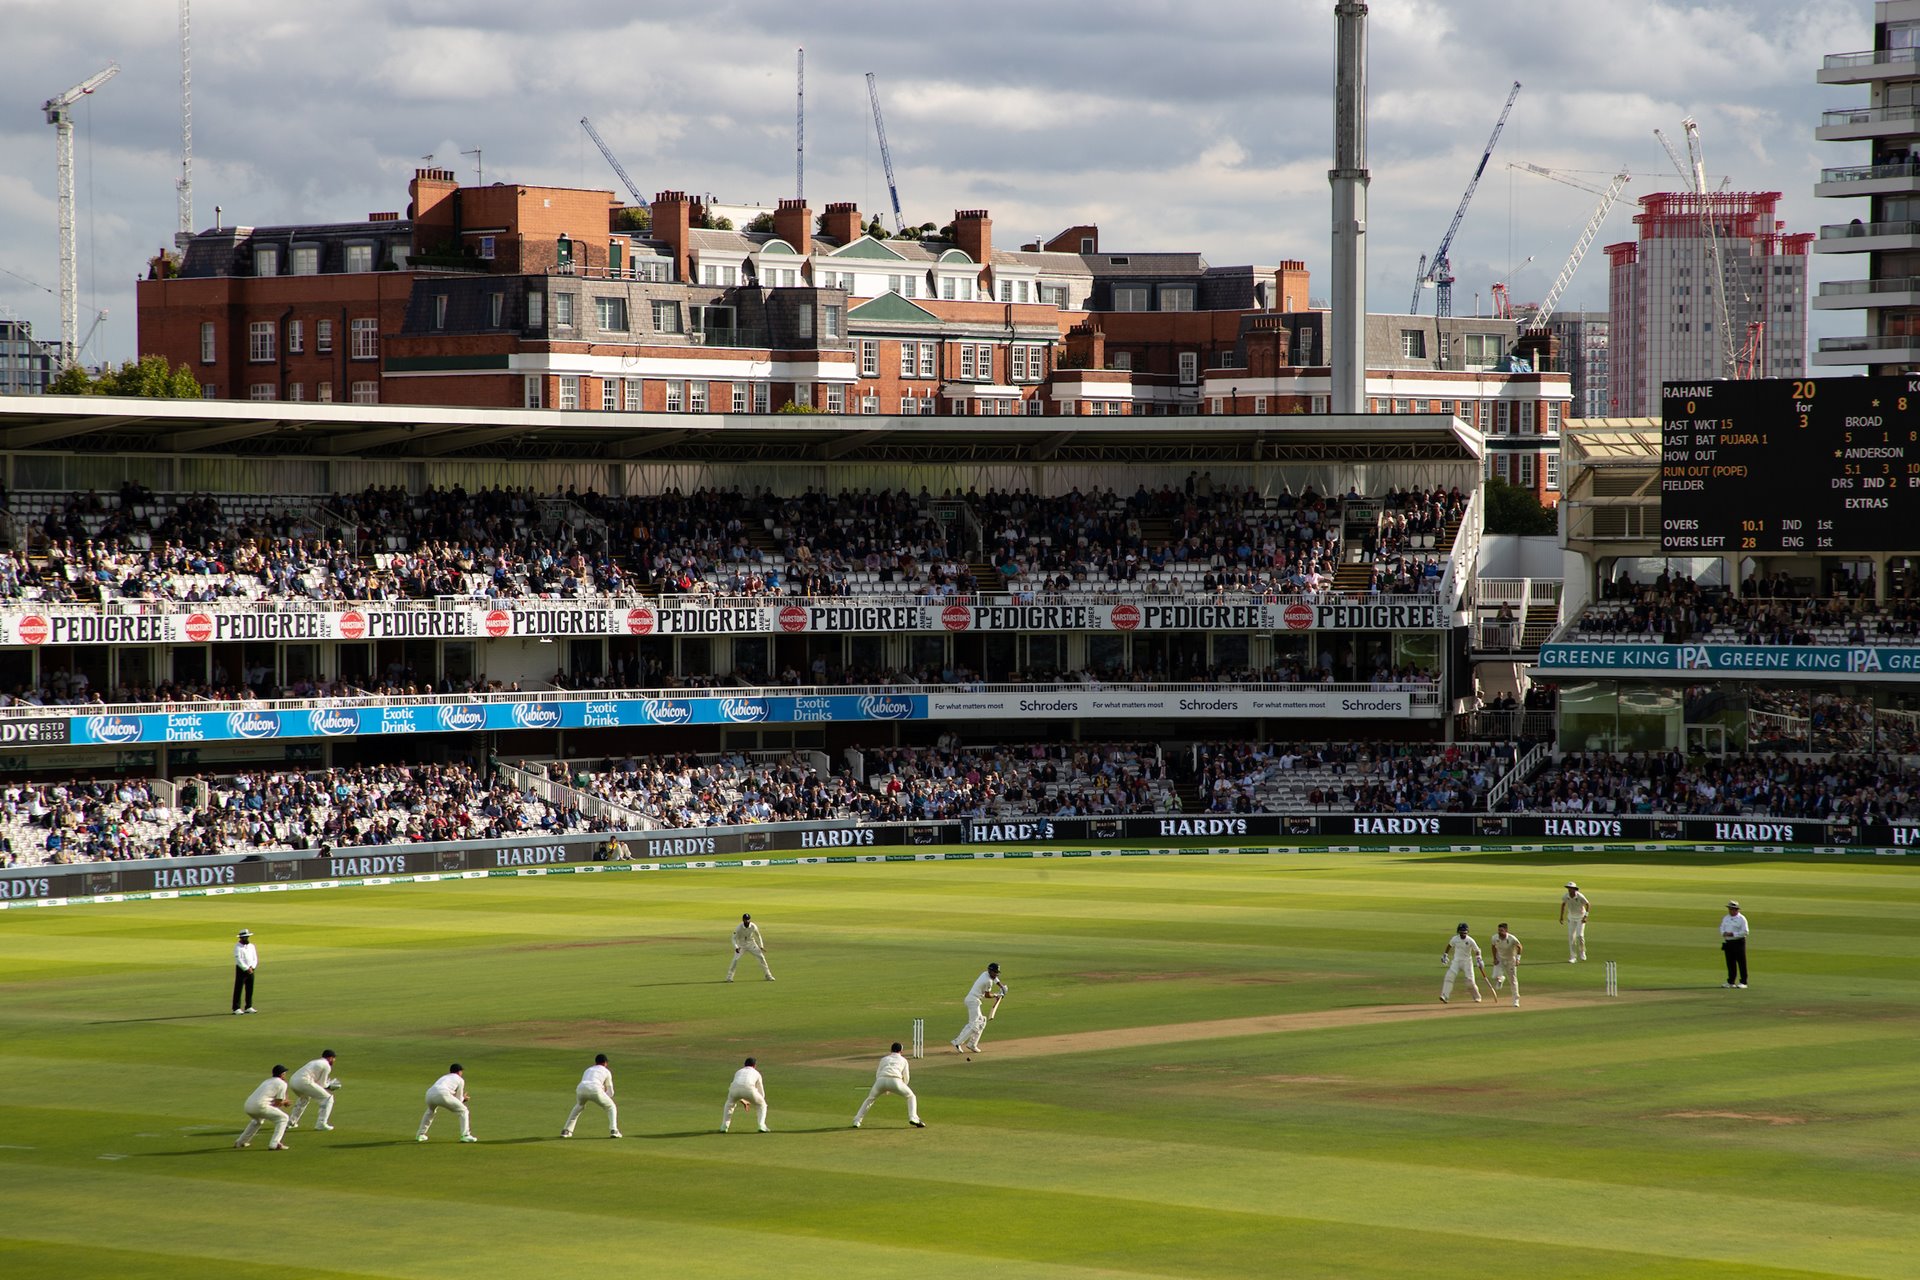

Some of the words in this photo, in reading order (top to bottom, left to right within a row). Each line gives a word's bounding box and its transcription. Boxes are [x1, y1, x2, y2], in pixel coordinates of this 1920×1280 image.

[1663, 386, 1713, 399] RAHANE
[1792, 381, 1816, 400] 20
[1687, 401, 1696, 414] 0
[1796, 401, 1813, 412] for
[1898, 397, 1907, 411] 8
[1664, 420, 1689, 431] LAST
[1694, 419, 1718, 430] WKT
[1721, 419, 1734, 430] 15
[1799, 414, 1809, 428] 3
[1845, 416, 1883, 427] BROAD
[1664, 435, 1689, 446] LAST
[1696, 435, 1717, 446] BAT
[1720, 434, 1759, 445] PUJARA
[1762, 435, 1769, 445] 1
[1845, 432, 1853, 443] 5
[1883, 432, 1889, 442] 1
[1910, 431, 1918, 441] 8
[1663, 450, 1690, 461] HOW
[1694, 450, 1717, 461] OUT
[1844, 447, 1905, 459] ANDERSON
[1664, 466, 1686, 477] RUN
[1688, 466, 1710, 477] OUT
[1712, 465, 1749, 478] (POPE)
[1844, 464, 1862, 475] 5.1
[1882, 464, 1890, 474] 3
[1663, 480, 1705, 491] FIELDER
[1831, 478, 1854, 489] DRS
[1863, 477, 1885, 488] IND
[1889, 477, 1898, 488] 2
[1845, 498, 1889, 509] EXTRAS
[1664, 520, 1700, 531] OVERS
[1742, 520, 1765, 532] 10.1
[1782, 520, 1803, 531] IND
[1817, 519, 1833, 530] 1st
[1664, 537, 1700, 548] OVERS
[1702, 536, 1726, 547] LEFT
[1742, 537, 1756, 549] 28
[1782, 537, 1805, 548] ENG
[1817, 536, 1833, 547] 1st
[512, 610, 607, 635] PEDIGREE
[656, 608, 758, 633] PEDIGREE
[810, 606, 918, 631] PEDIGREE
[974, 605, 1086, 630] PEDIGREE
[1143, 604, 1259, 629] PEDIGREE
[1316, 604, 1436, 629] PEDIGREE
[51, 615, 162, 642] PEDIGREE
[215, 612, 317, 640] PEDIGREE
[368, 611, 465, 637] PEDIGREE
[1544, 650, 1616, 665] GREENE
[1623, 651, 1670, 665] KING
[1676, 645, 1713, 669] IPA
[1719, 652, 1789, 667] GREENE
[1796, 653, 1841, 668] KING
[1847, 647, 1883, 673] IPA
[586, 702, 617, 714] Exotic
[645, 699, 687, 720] Rubicon
[722, 697, 765, 717] Rubicon
[796, 698, 830, 709] Exotic
[860, 695, 909, 715] Rubicon
[1020, 699, 1078, 711] Schroders
[1180, 699, 1238, 711] Schroders
[1342, 699, 1402, 711] Schroders
[311, 708, 355, 728] Rubicon
[383, 708, 414, 720] Exotic
[441, 705, 482, 725] Rubicon
[516, 702, 558, 722] Rubicon
[793, 710, 832, 721] Drinks
[90, 715, 138, 738] Rubicon
[168, 714, 202, 727] Exotic
[231, 711, 276, 732] Rubicon
[584, 714, 619, 726] Drinks
[1, 722, 39, 743] DYS
[40, 722, 65, 731] ESTD
[381, 721, 416, 733] Drinks
[40, 731, 65, 741] 1853
[166, 728, 203, 741] Drinks
[1160, 819, 1246, 836] HARDYS
[1354, 817, 1440, 834] HARDYS
[1544, 819, 1621, 837] HARDYS
[1715, 822, 1793, 842] HARDYS
